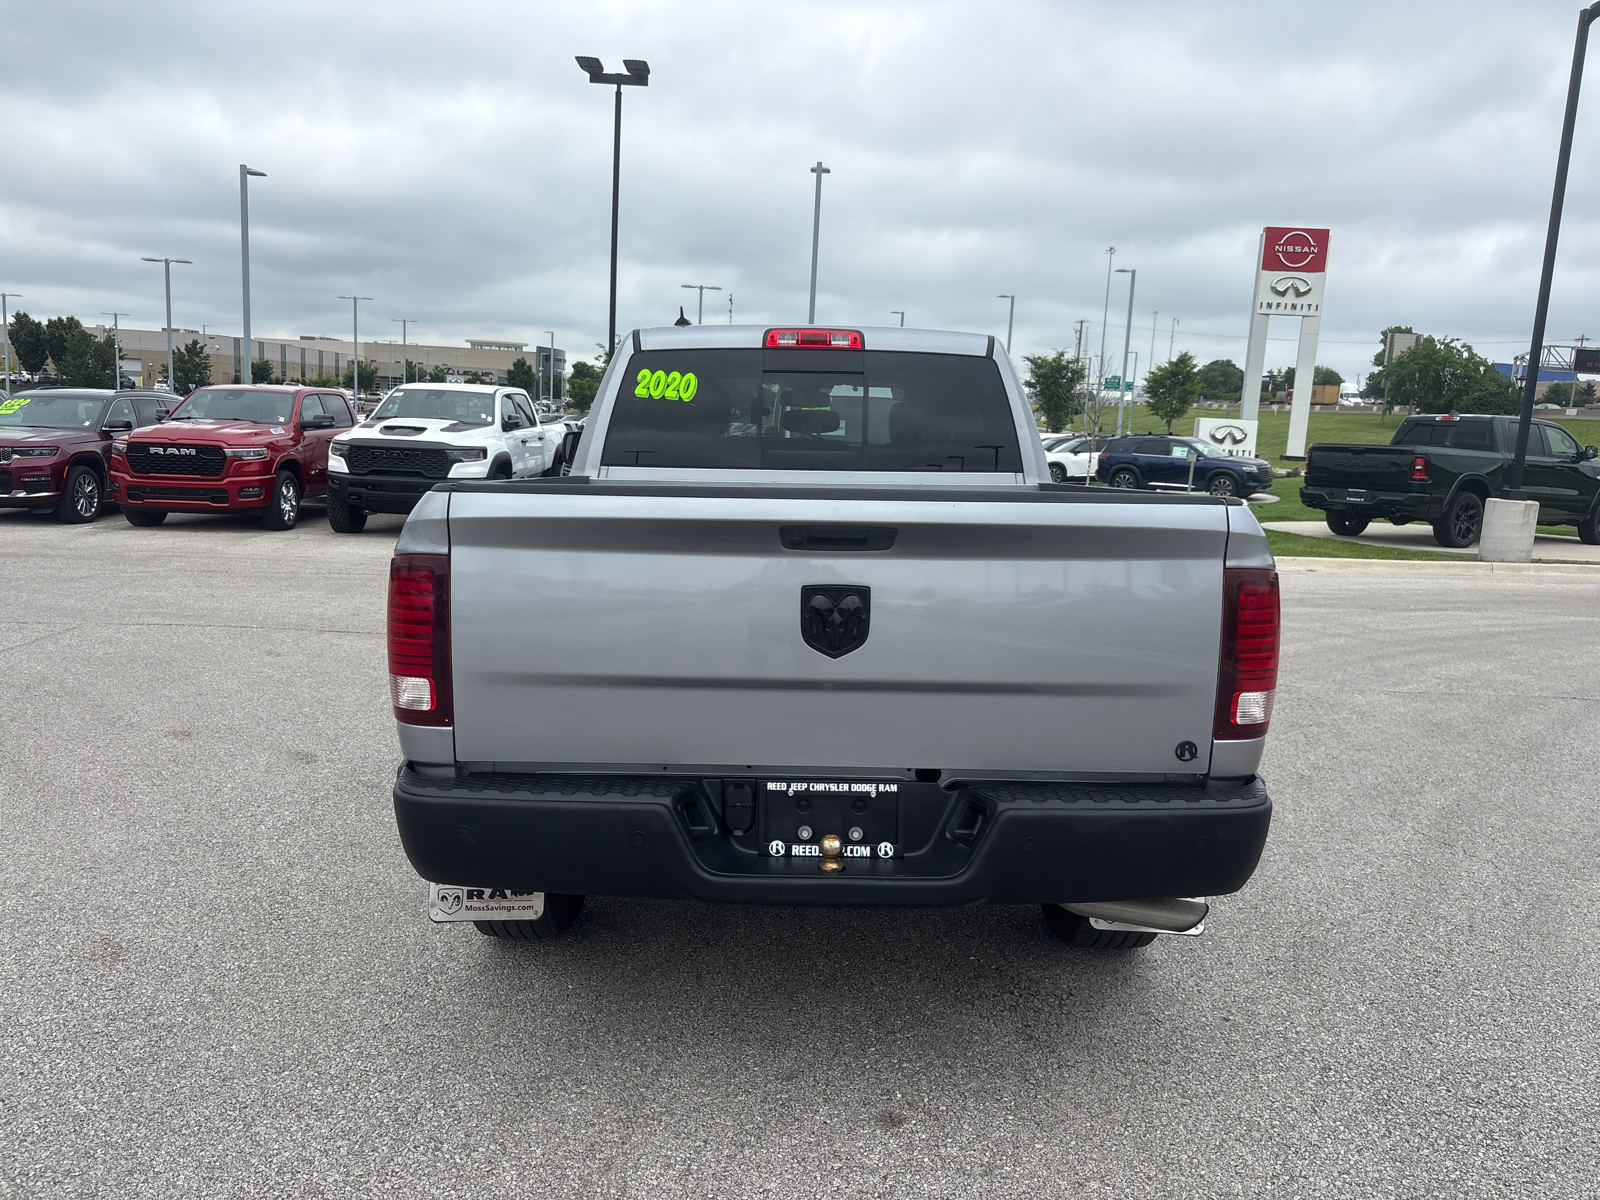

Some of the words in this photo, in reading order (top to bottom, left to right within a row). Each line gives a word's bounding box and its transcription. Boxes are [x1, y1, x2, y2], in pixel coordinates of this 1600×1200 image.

[1275, 245, 1318, 253] NISSAN
[1260, 302, 1319, 311] INFINITI
[634, 368, 698, 402] 2020
[149, 446, 197, 456] RAM
[370, 449, 422, 460] RAM
[767, 782, 787, 791] REED
[789, 782, 808, 792] JEEP
[809, 783, 849, 792] CHRYSLER
[850, 783, 877, 792] DODGE
[878, 784, 898, 792] RAM
[465, 904, 534, 913] MossSavings.com
